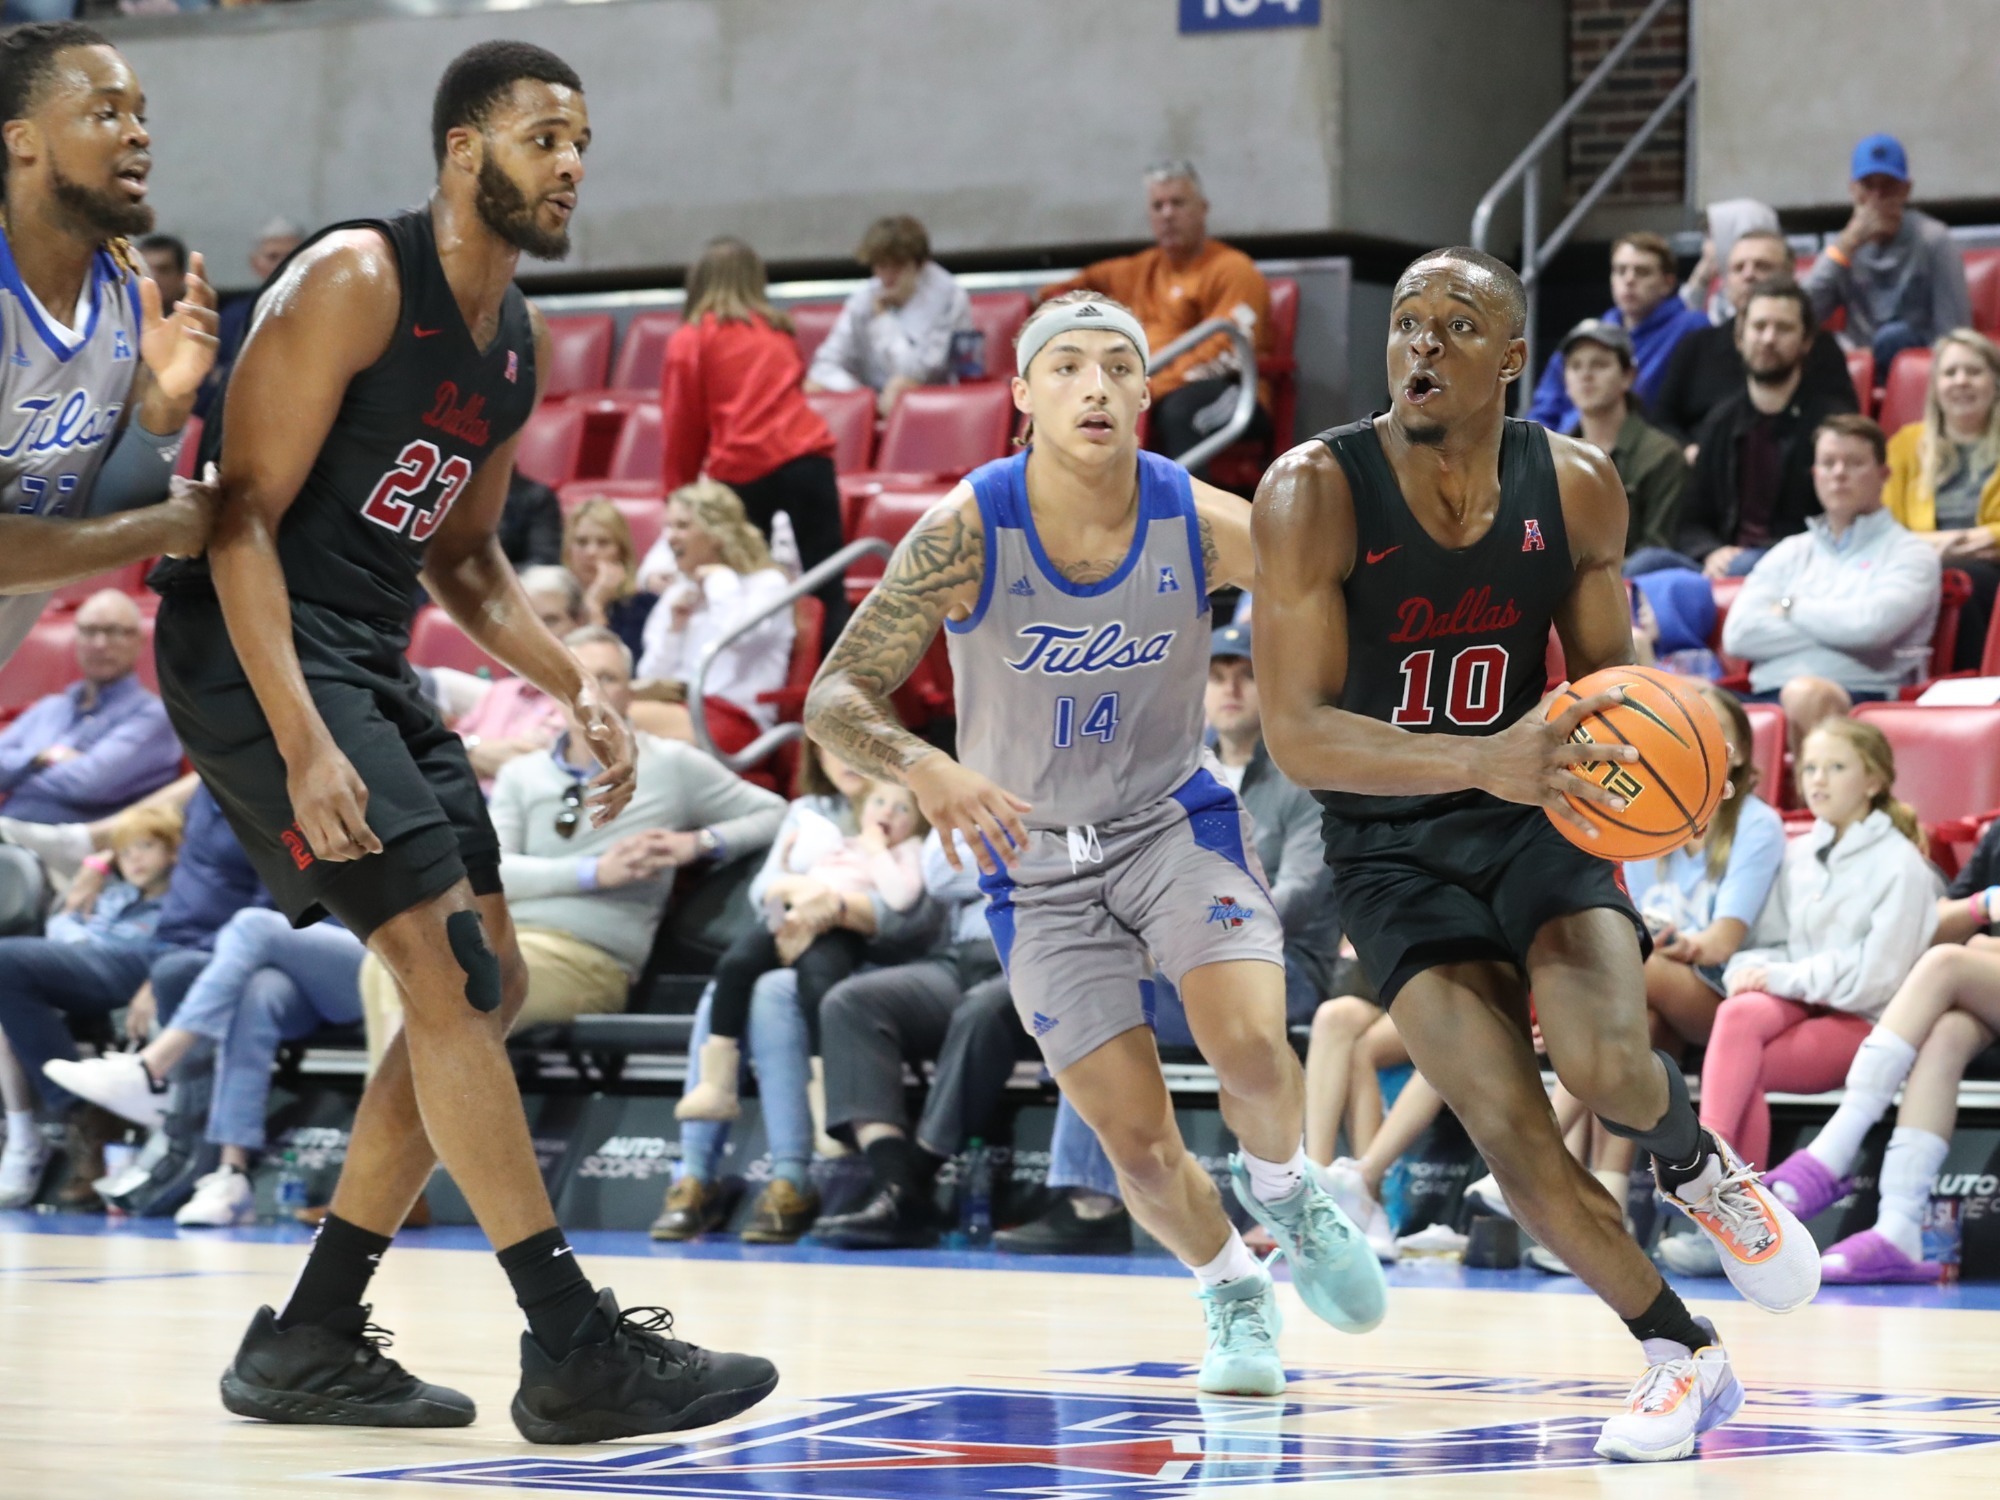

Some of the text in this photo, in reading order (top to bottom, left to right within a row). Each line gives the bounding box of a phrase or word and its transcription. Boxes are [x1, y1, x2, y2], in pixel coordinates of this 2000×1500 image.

[360, 438, 473, 542] 23
[1388, 585, 1522, 643] Dallas
[1002, 619, 1178, 677] Tulsa
[1390, 643, 1510, 726] 10
[1053, 690, 1120, 749] 14
[597, 1136, 667, 1158] AUTO
